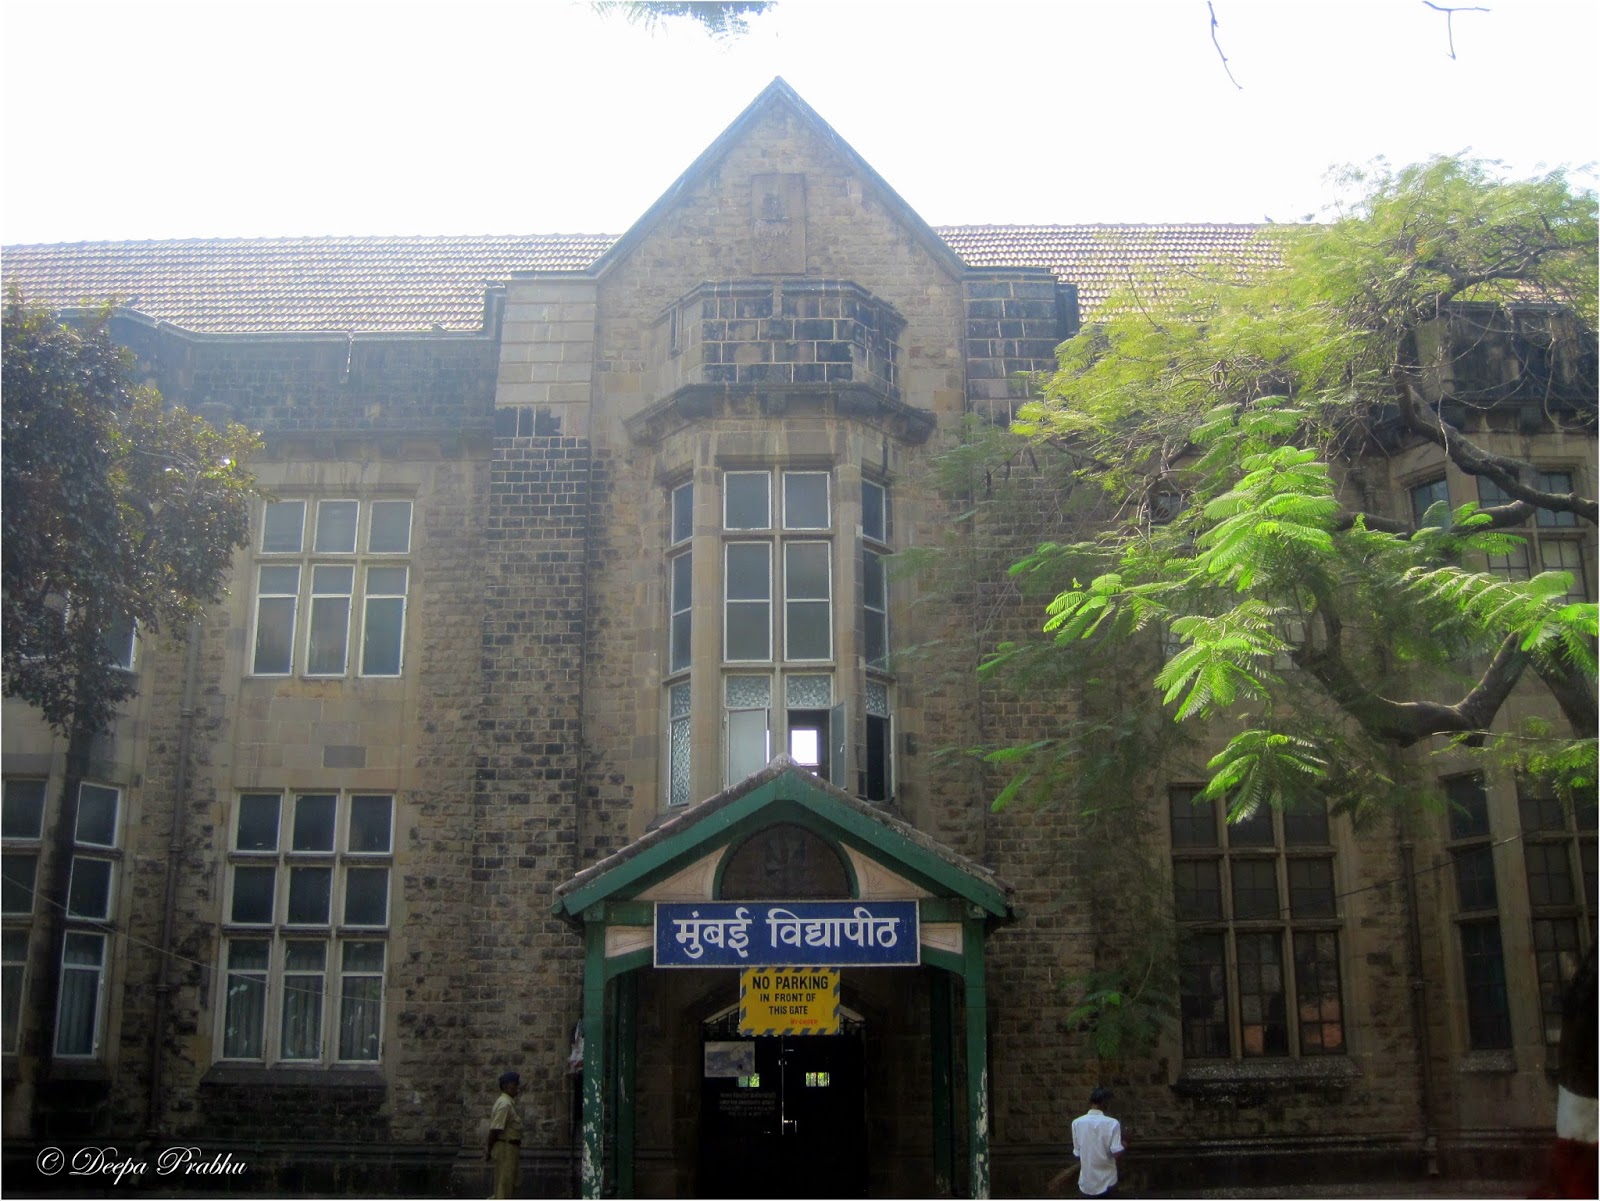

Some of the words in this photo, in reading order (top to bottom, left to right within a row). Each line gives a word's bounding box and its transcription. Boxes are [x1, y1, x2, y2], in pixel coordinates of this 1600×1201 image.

[672, 907, 753, 958] मुंबई
[766, 907, 900, 948] विद्यापीठ
[752, 976, 770, 990] NO
[776, 976, 829, 990] PARKING
[760, 993, 770, 1002] IN
[775, 993, 804, 1002] FRONT
[806, 993, 816, 1002] OF
[769, 1006, 788, 1015] THIS
[789, 1006, 808, 1015] GATE
